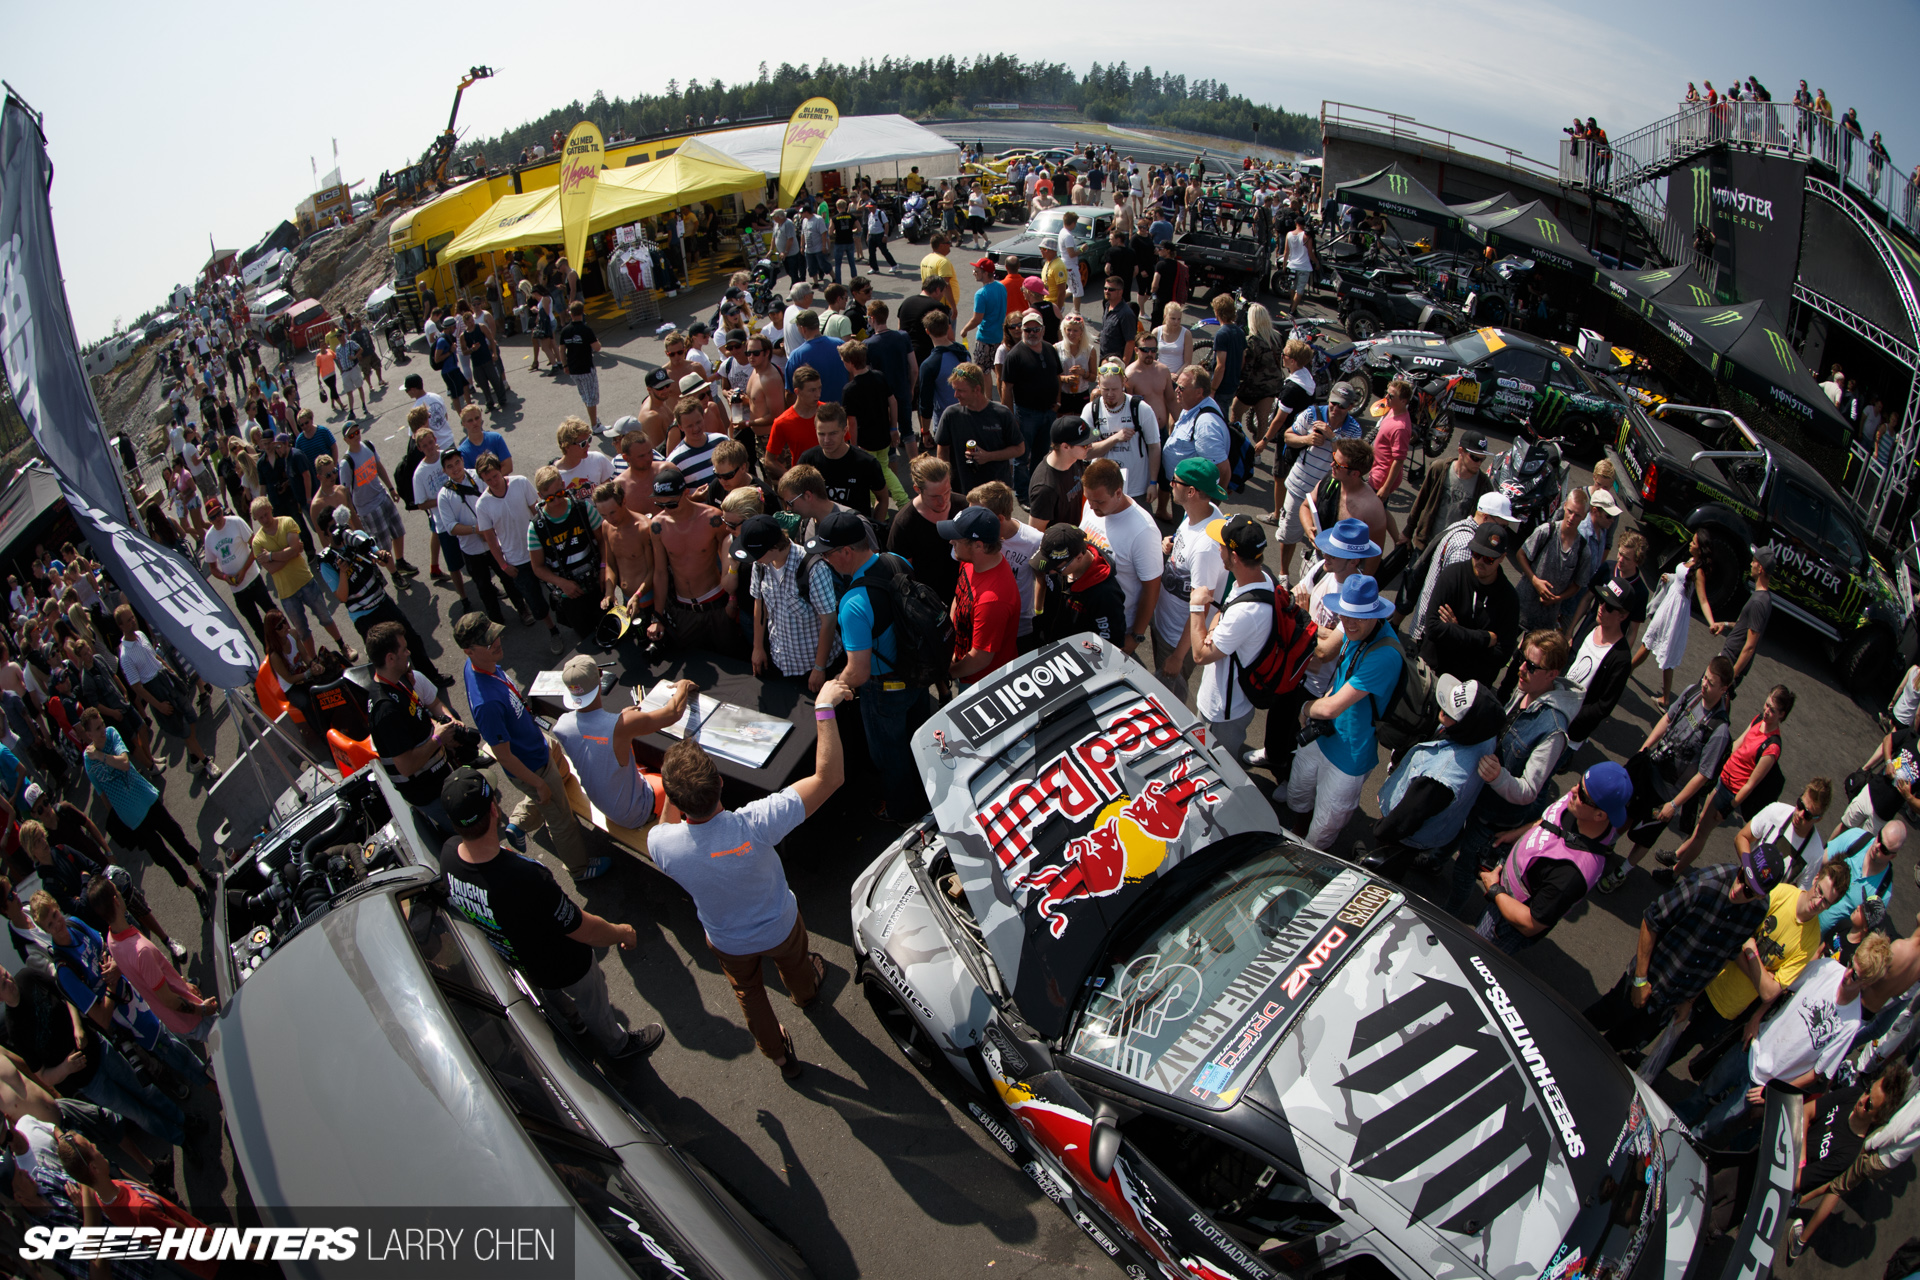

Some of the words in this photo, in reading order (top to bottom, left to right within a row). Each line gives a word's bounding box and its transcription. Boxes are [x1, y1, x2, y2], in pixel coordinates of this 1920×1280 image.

[798, 112, 823, 120] GATEBIL
[580, 135, 593, 144] MED
[787, 121, 828, 145] Vegas
[566, 145, 590, 155] GATEBIL
[590, 143, 600, 152] TIL
[562, 156, 599, 194] Vegas
[317, 188, 341, 204] JCB
[1378, 201, 1418, 216] MONSTER
[1712, 186, 1773, 221] MONSTER
[1718, 210, 1764, 232] ENERGY
[1531, 248, 1573, 269] MONSTER
[1350, 287, 1366, 296] ARCTIC
[1366, 290, 1376, 298] CAT
[1668, 319, 1694, 346] MONSTER
[1519, 384, 1534, 392] DEKK
[1770, 386, 1813, 419] MONSTER
[1450, 403, 1475, 415] Garrett
[546, 525, 585, 547] GATEIL
[221, 545, 231, 557] M
[1005, 549, 1028, 565] CRUZ
[1767, 538, 1842, 594] MONSTER
[995, 651, 1084, 716] Mobil
[319, 693, 345, 707] ATTACK
[1071, 692, 1183, 801] Red
[969, 750, 1103, 878] Bull
[447, 872, 489, 907] VAUGHN
[1336, 884, 1394, 928] CODY'S
[1280, 926, 1348, 1001] D1NZ
[872, 947, 935, 1021] Achilles
[1211, 1010, 1261, 1067] CHAMPIONS
[1228, 1032, 1263, 1071] NATIONA
[1469, 955, 1586, 1159] SPEEDHUNTERS.com
[977, 1111, 1019, 1154] etnies
[1089, 1222, 1118, 1254] TEIN
